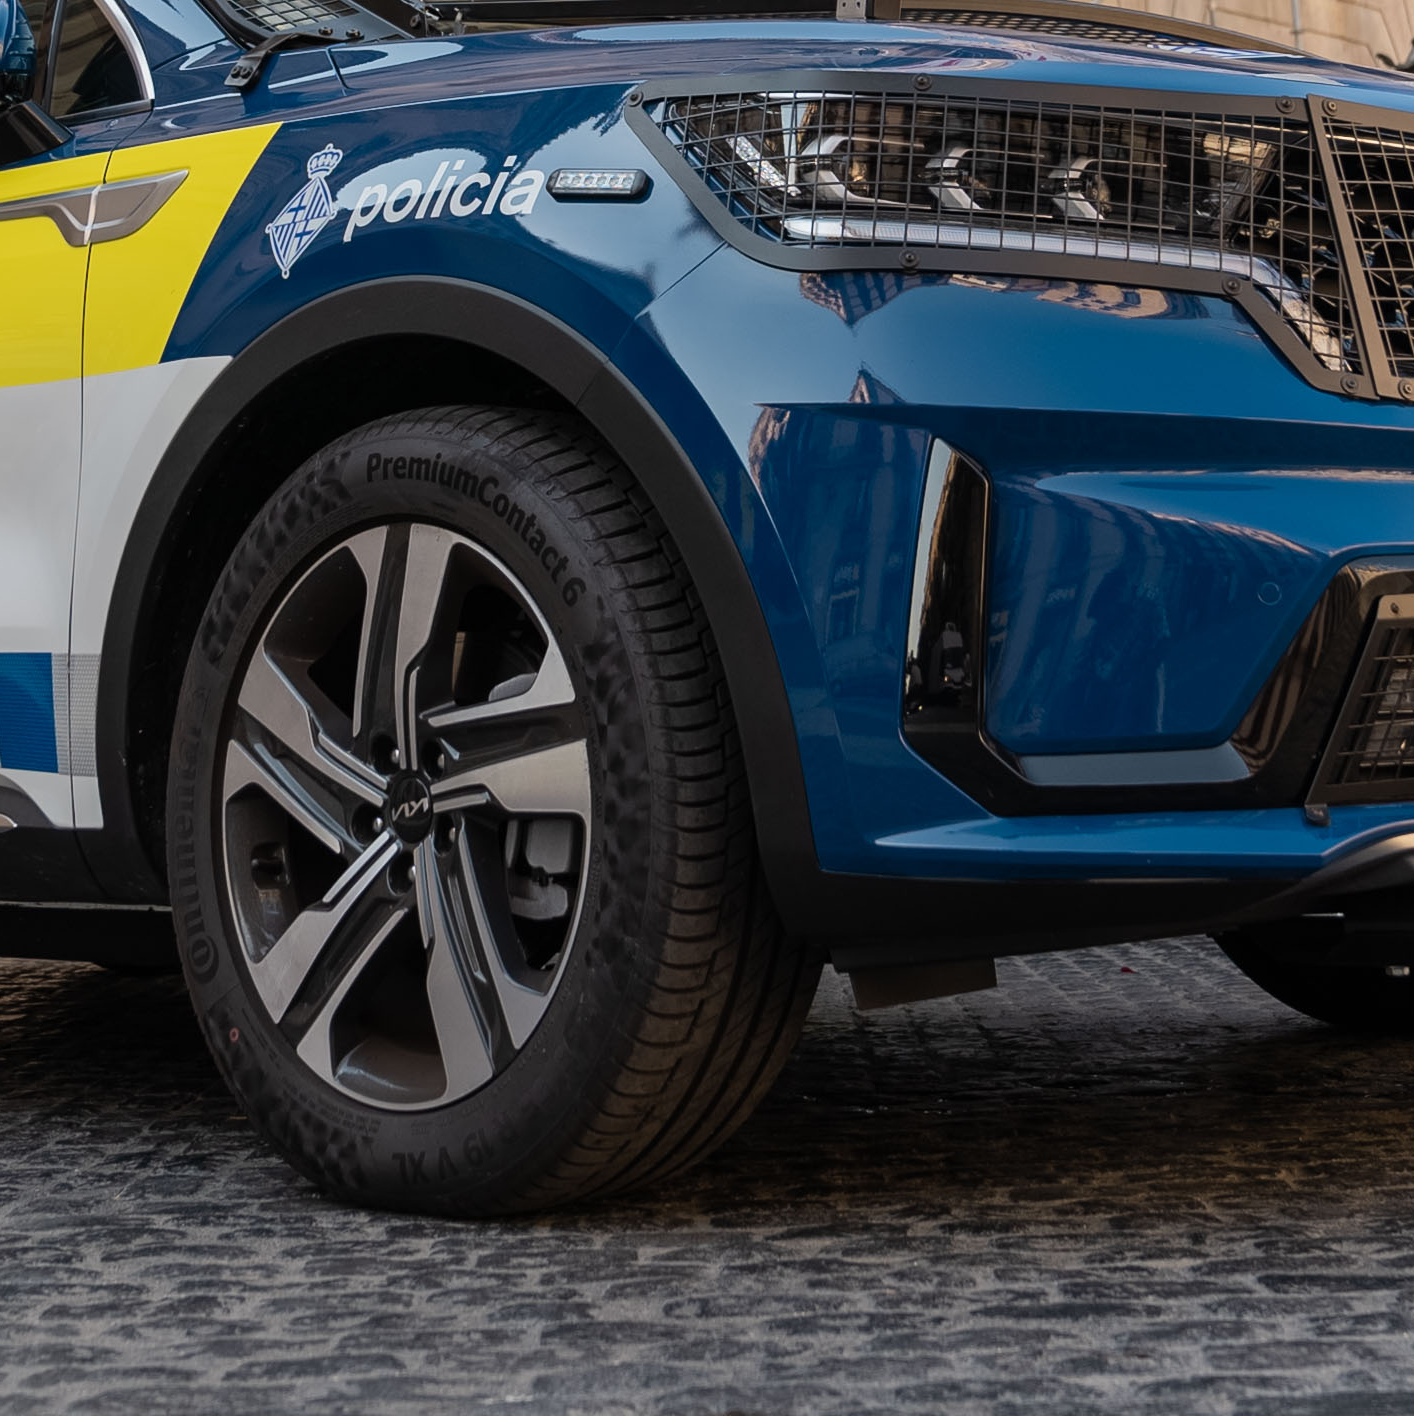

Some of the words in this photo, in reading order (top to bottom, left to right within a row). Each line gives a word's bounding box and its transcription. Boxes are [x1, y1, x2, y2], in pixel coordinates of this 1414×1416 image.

[342, 155, 545, 243] policia
[366, 452, 570, 584] PremiumContact
[561, 577, 587, 608] 6
